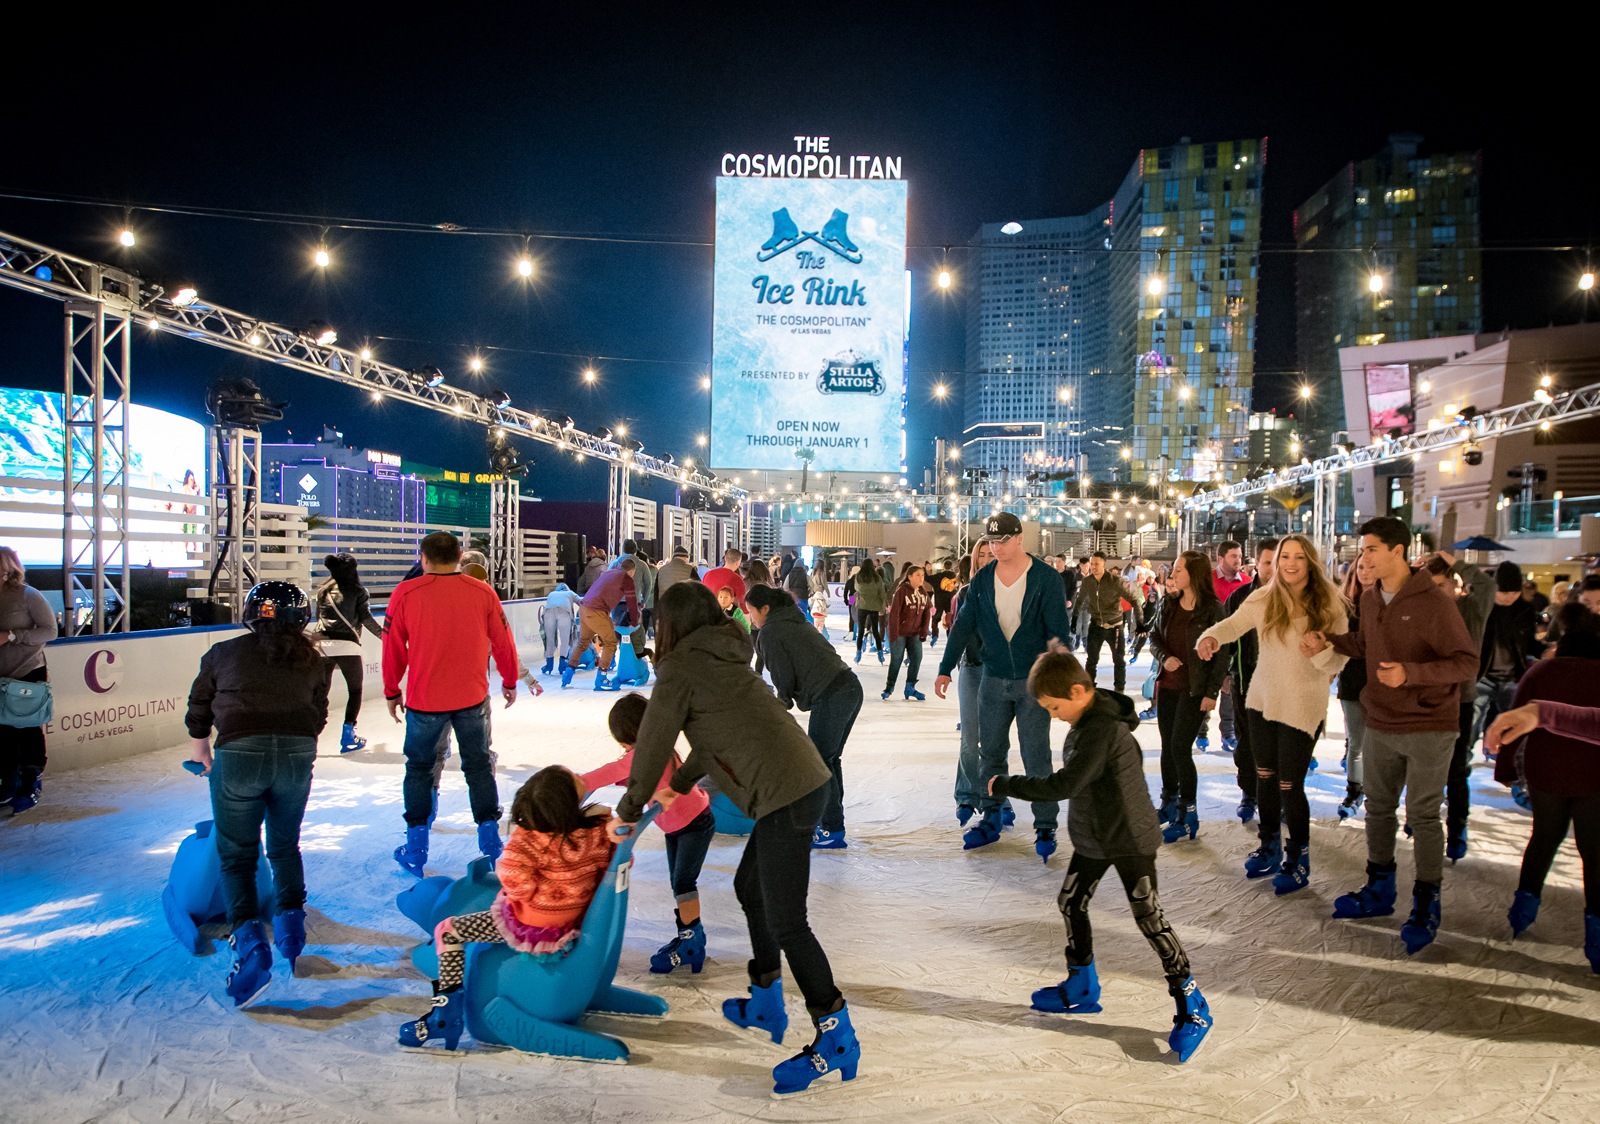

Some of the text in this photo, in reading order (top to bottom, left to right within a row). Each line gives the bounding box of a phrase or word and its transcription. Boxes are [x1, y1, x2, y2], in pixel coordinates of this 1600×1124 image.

[794, 136, 830, 153] THE
[721, 153, 902, 180] COSMOPOLITAN
[796, 250, 826, 269] The
[751, 275, 867, 306] Ice Rink
[756, 314, 777, 326] THE
[741, 370, 795, 380] PRESENTED
[829, 366, 874, 378] STELLA
[828, 377, 875, 388] ARTOIS
[776, 420, 840, 433] OPEN NOW
[746, 434, 868, 448] THROUGH JANUARY 1
[366, 662, 379, 675] THE
[77, 724, 134, 743] of LAS VEGAS
